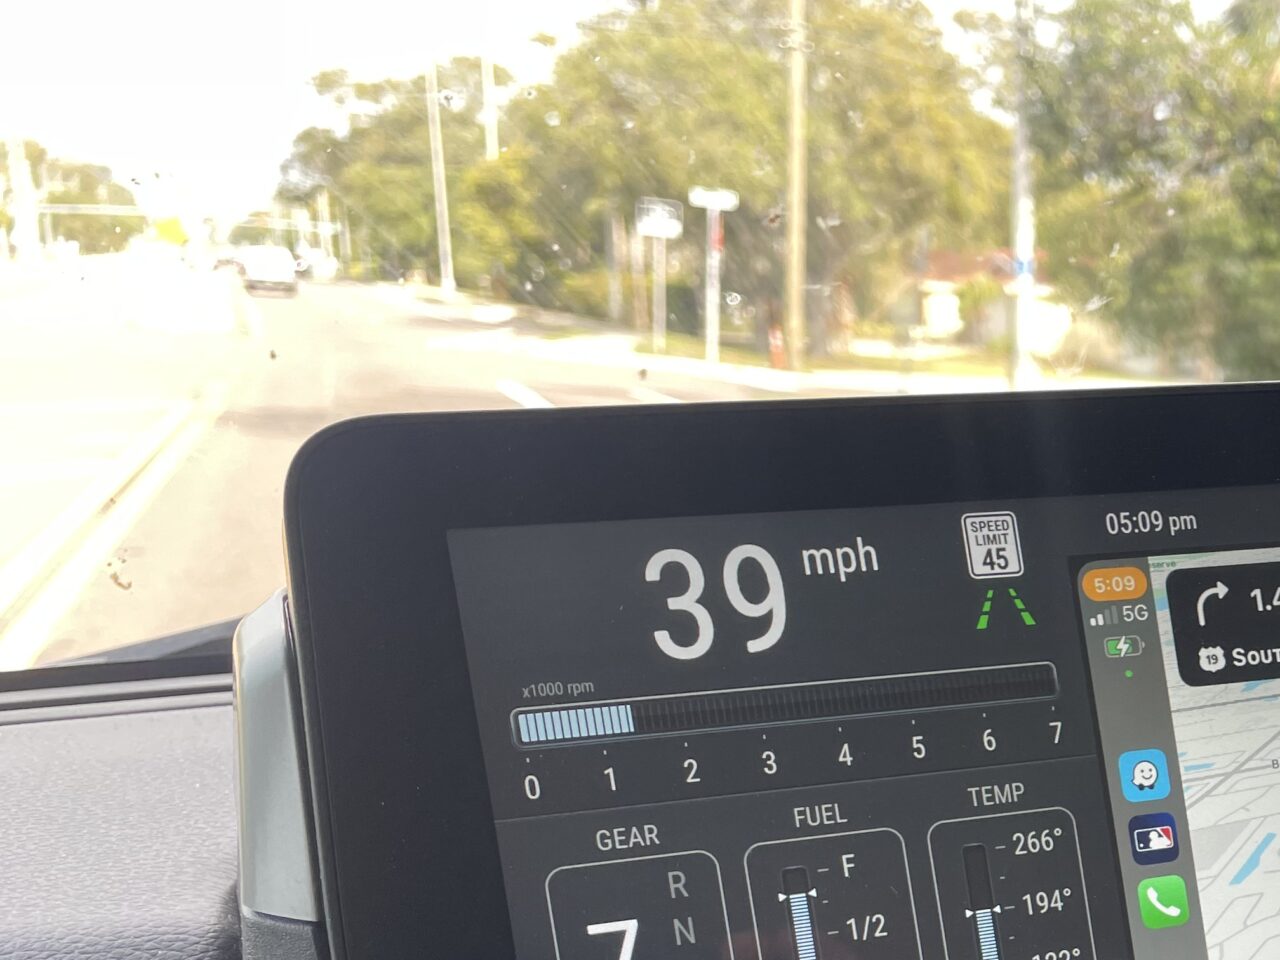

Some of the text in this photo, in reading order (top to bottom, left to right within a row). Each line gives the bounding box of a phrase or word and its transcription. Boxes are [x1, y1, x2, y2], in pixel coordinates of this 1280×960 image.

[970, 519, 1010, 533] SPEED
[1106, 511, 1197, 535] 05:09 pm
[975, 533, 1009, 546] LIMIT
[982, 547, 1009, 571] 45
[1094, 576, 1135, 593] 5:09
[644, 537, 879, 660] 39 mph
[1122, 604, 1149, 622] 5G
[1205, 654, 1218, 665] 19
[521, 682, 594, 698] x1000 rpm
[983, 729, 997, 752] 6
[1049, 722, 1063, 745] 7
[838, 744, 853, 766] 4
[912, 736, 926, 759] 5
[684, 760, 700, 784] 2
[763, 751, 777, 775] 3
[524, 775, 540, 799] 0
[604, 766, 617, 791] 1
[967, 782, 1025, 807] TEMP
[793, 803, 848, 828] FUEL
[595, 824, 660, 851] GEAR
[1012, 828, 1063, 854] 266°
[841, 855, 855, 877] F
[668, 872, 689, 898] R
[1021, 888, 1072, 915] 194°
[673, 918, 696, 945] N
[846, 915, 888, 941] 1/2
